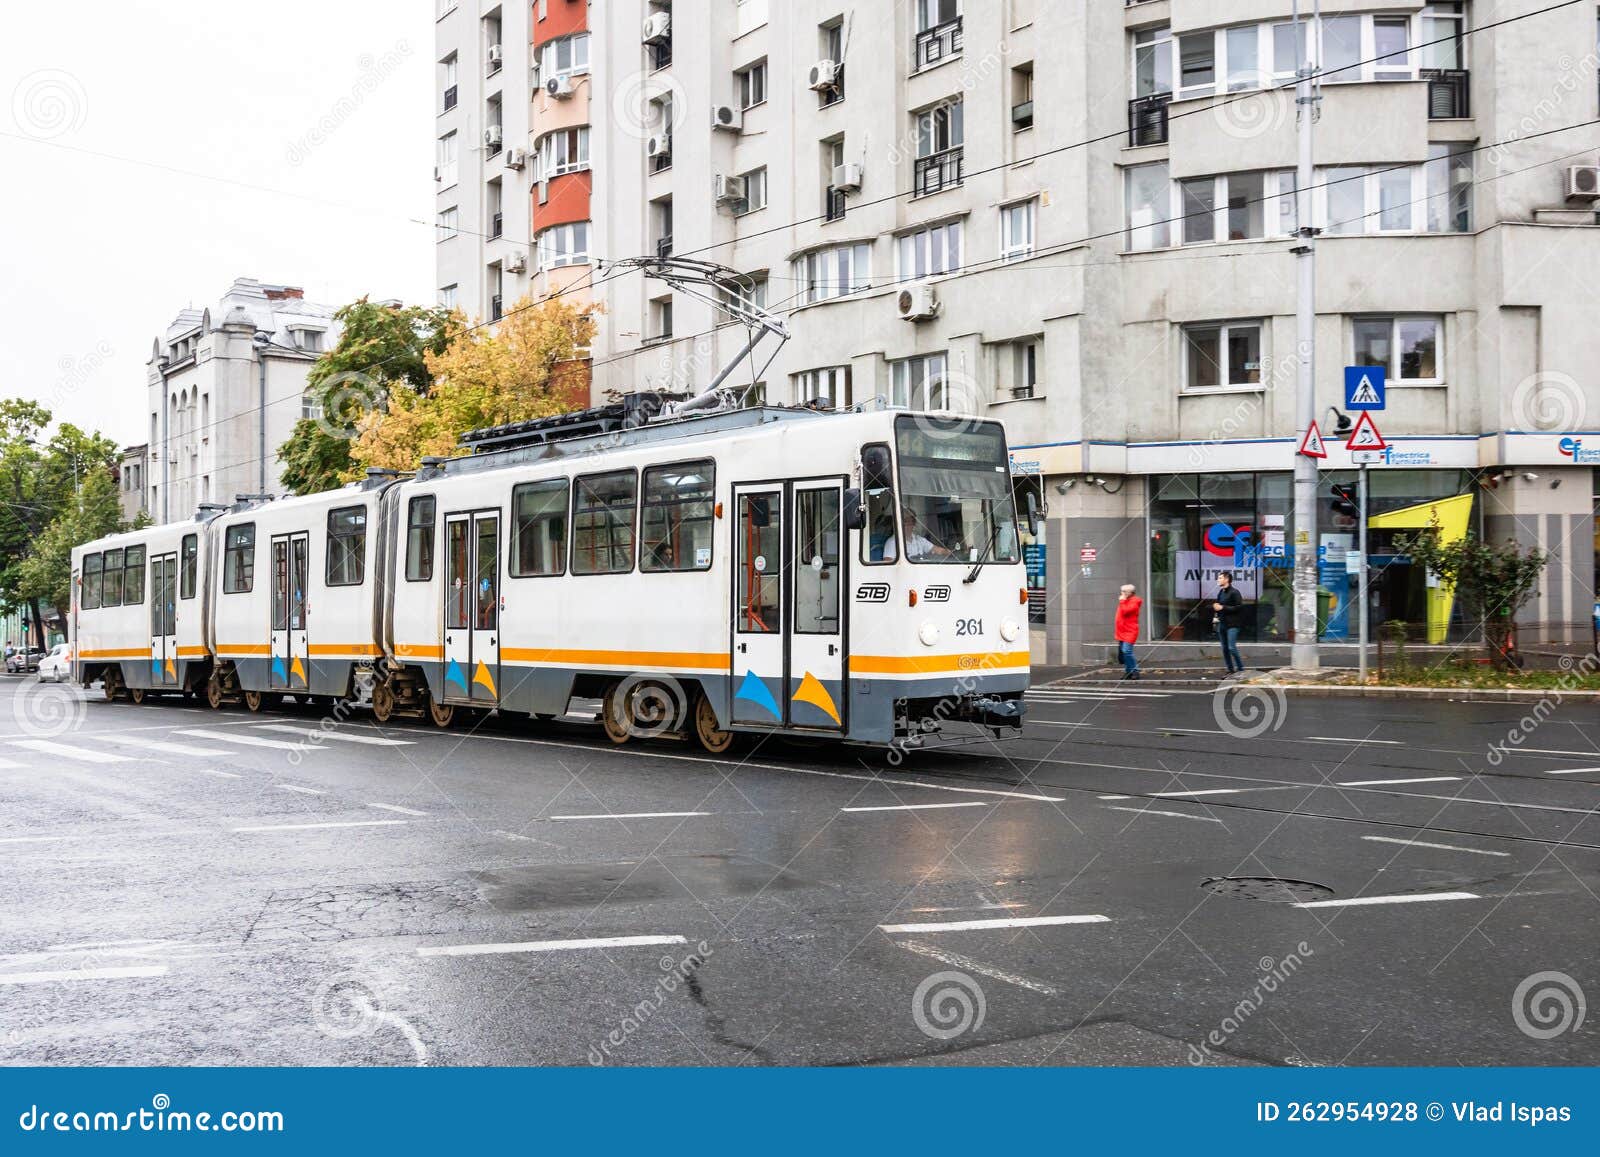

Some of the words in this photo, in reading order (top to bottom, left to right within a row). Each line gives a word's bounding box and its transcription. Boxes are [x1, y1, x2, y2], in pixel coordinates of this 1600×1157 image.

[1184, 569, 1254, 581] AVITCH
[856, 586, 888, 600] STB
[924, 587, 949, 600] STB
[956, 618, 984, 635] 261
